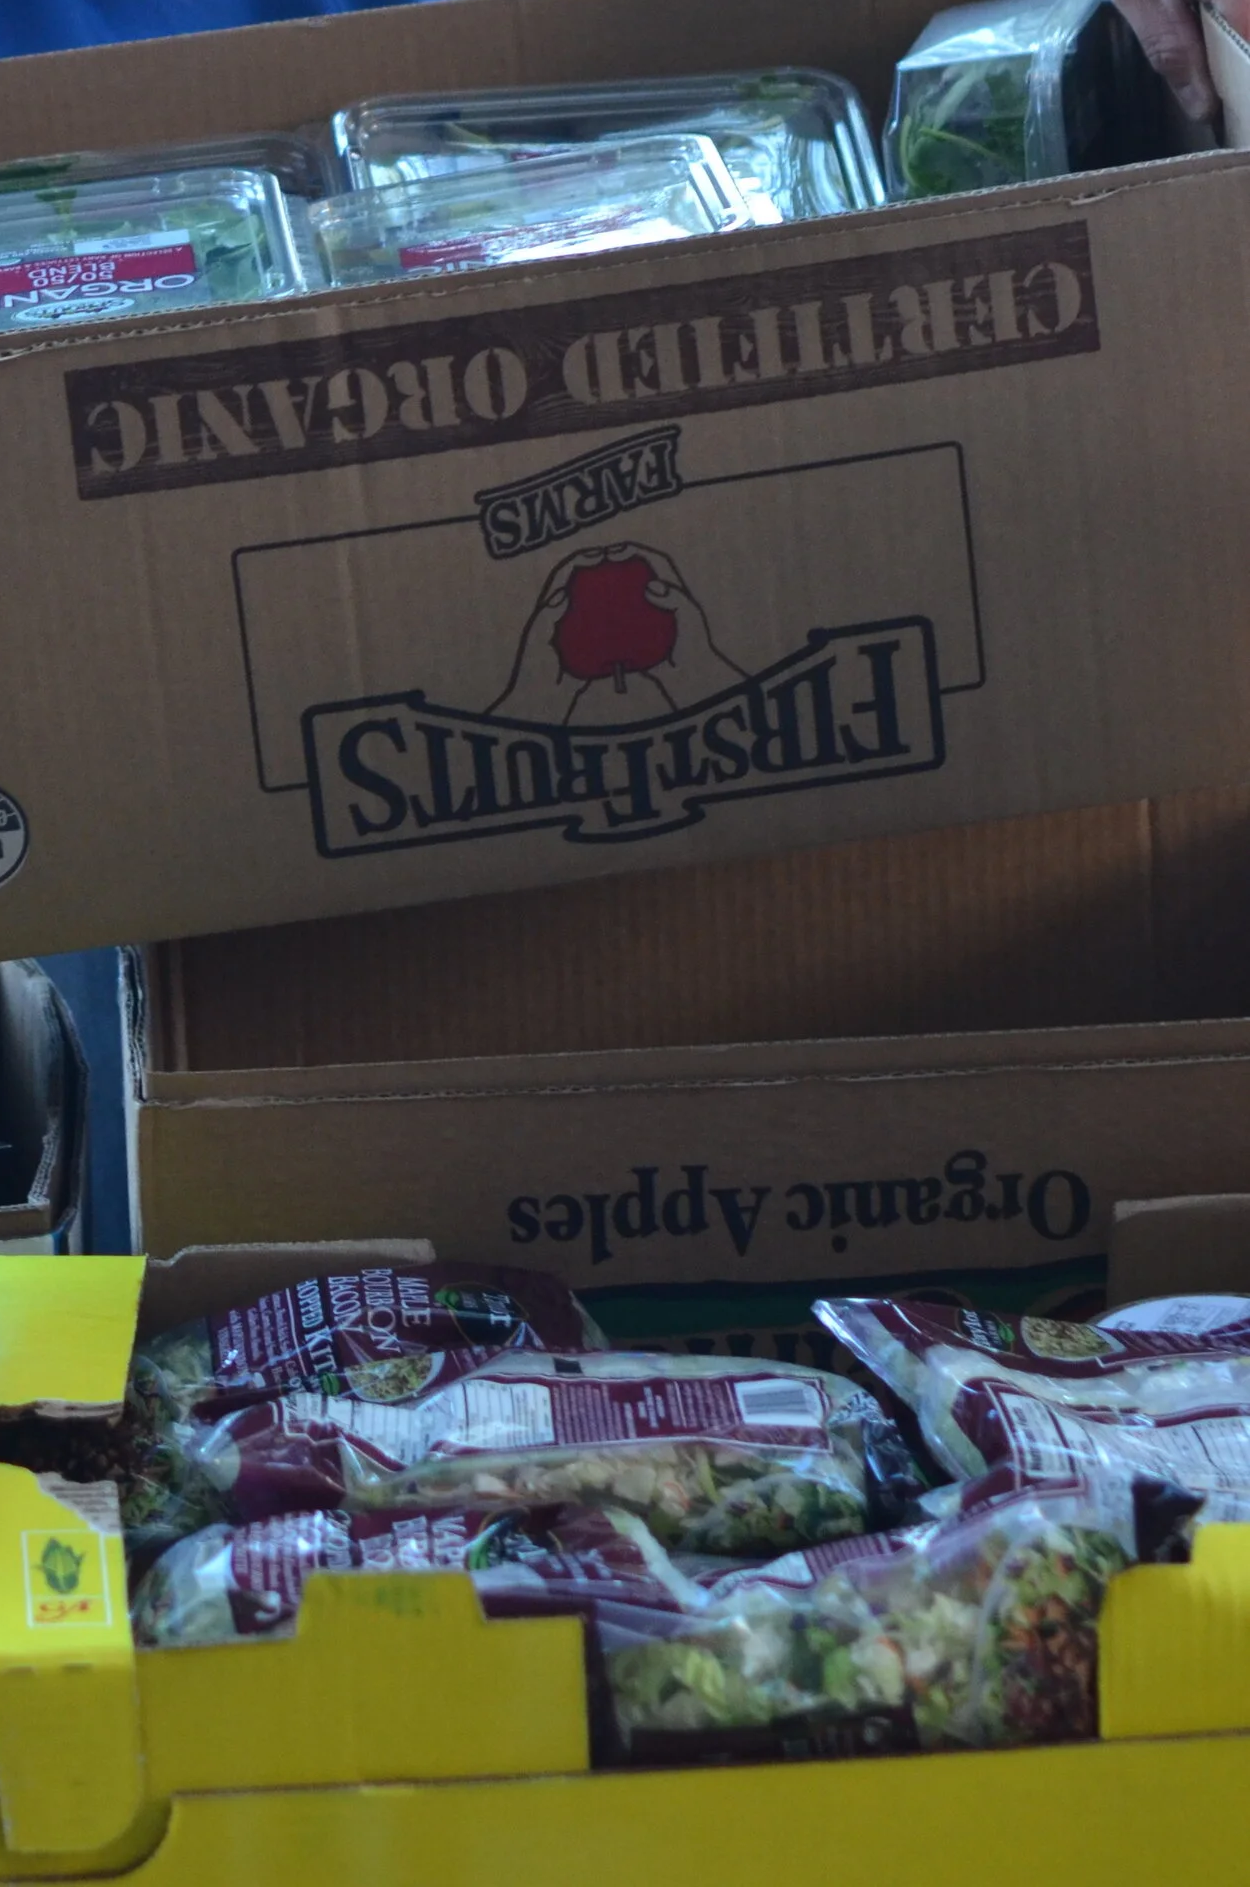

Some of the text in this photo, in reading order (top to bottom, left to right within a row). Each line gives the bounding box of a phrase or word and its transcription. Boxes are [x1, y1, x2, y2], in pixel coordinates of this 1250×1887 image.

[28, 261, 116, 277] BLEND
[32, 271, 113, 287] 50/50
[83, 258, 1082, 479] CERTIFIED ORGANIC
[483, 436, 672, 553] FARMS
[506, 1149, 1091, 1264] Organic Apples
[328, 1276, 363, 1334] BACON
[361, 1269, 401, 1354] BOURBON
[397, 1277, 431, 1327] MAPLE
